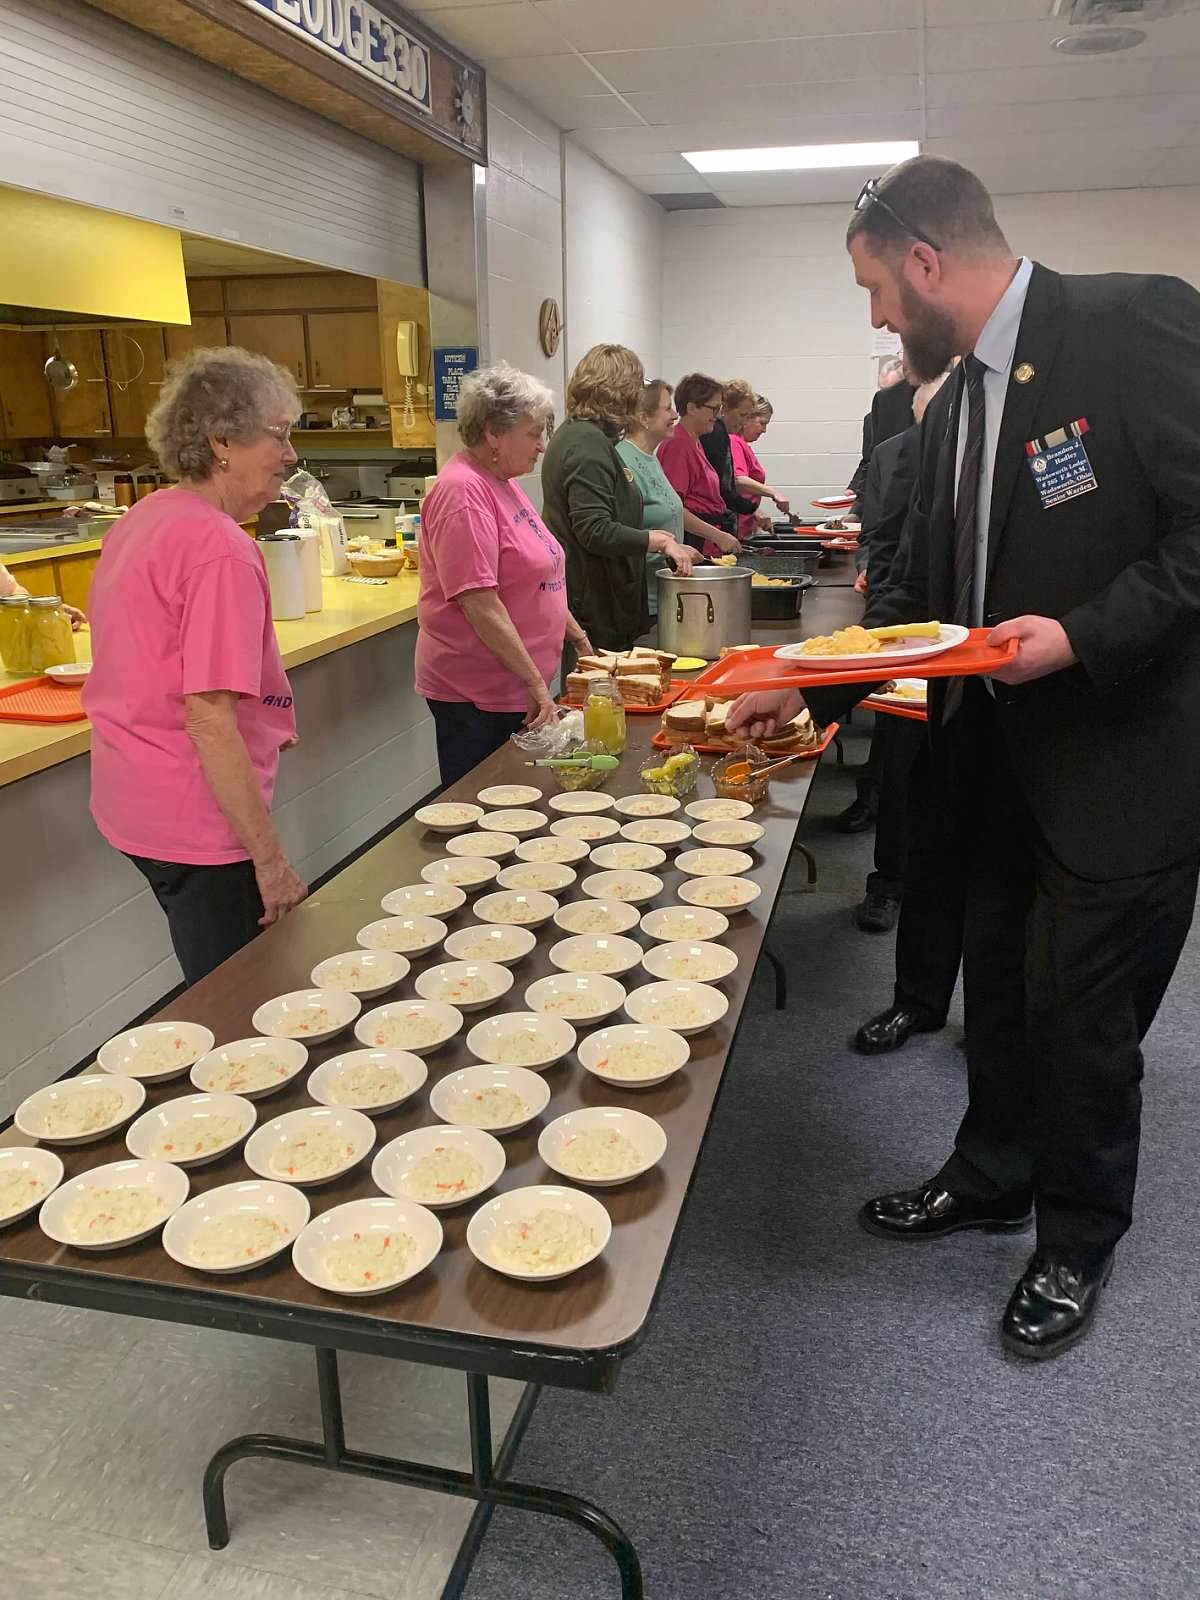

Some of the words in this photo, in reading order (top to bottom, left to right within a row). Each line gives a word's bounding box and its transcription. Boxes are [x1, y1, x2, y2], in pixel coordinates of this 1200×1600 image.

[1045, 493, 1066, 505] Senior
[1066, 483, 1092, 496] Warden
[262, 695, 293, 709] AND
